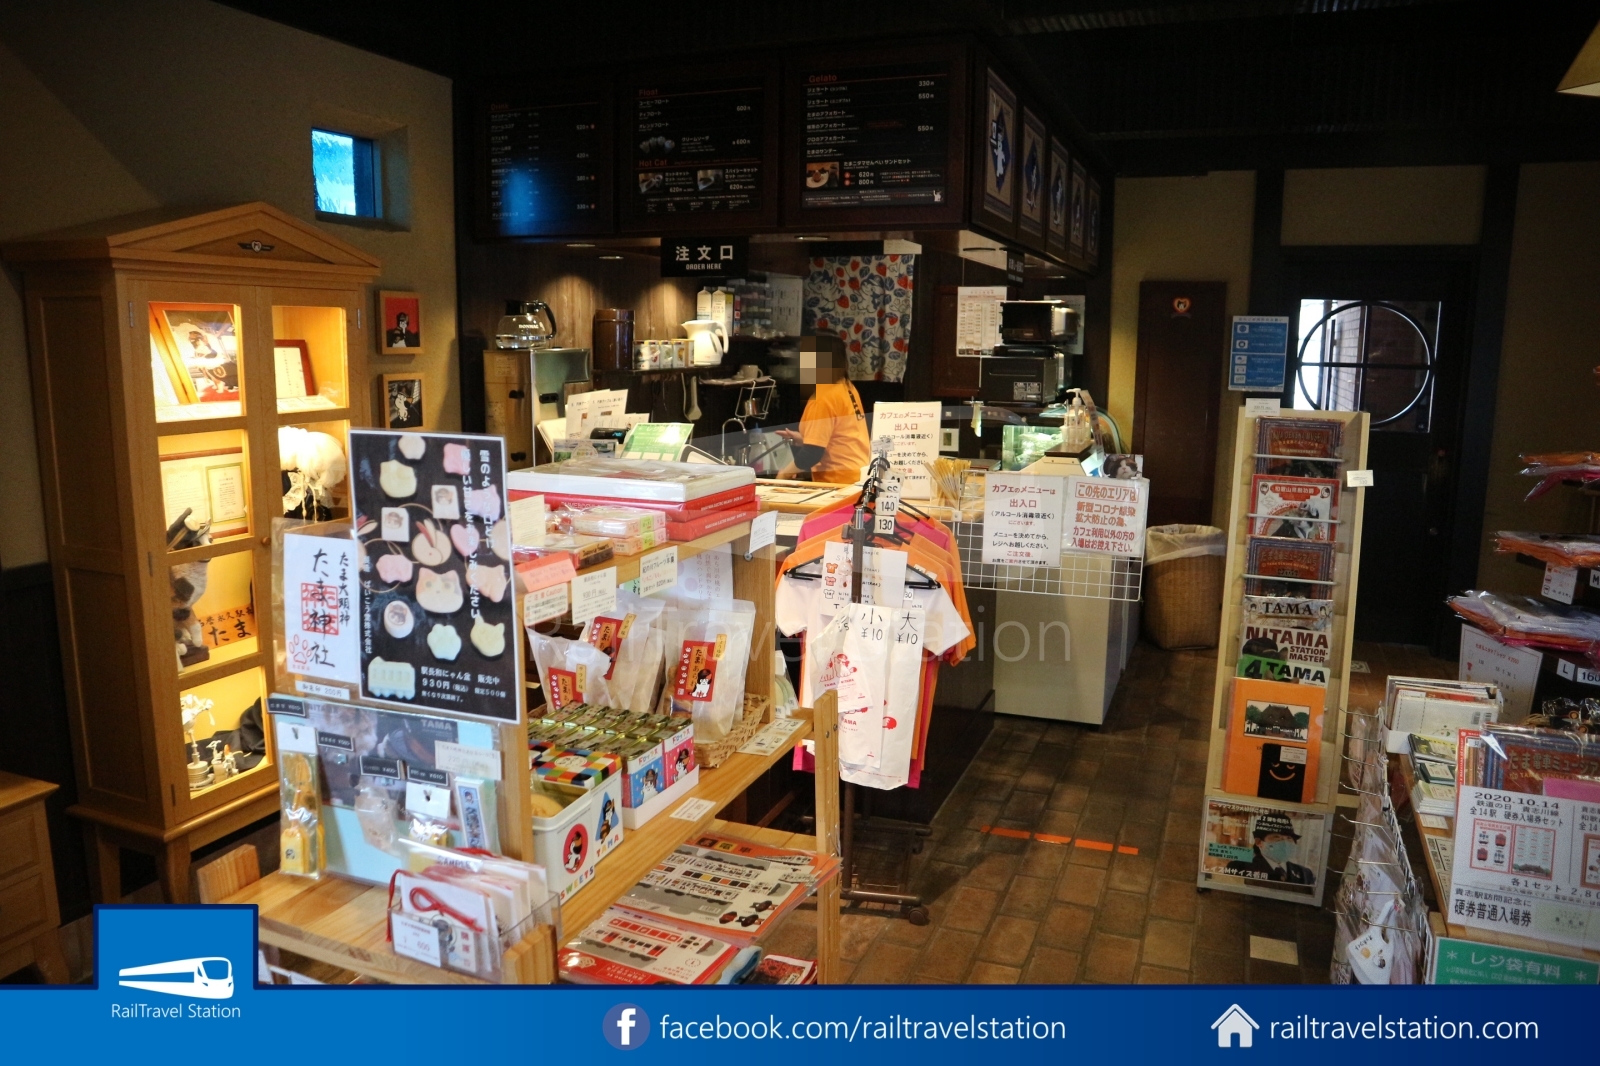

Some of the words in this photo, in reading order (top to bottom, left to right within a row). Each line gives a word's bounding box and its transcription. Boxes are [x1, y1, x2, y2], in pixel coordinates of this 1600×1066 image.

[809, 74, 837, 83] Gelato
[639, 88, 658, 96] Float
[639, 160, 653, 168] Hot
[675, 244, 734, 261] 注文口
[706, 262, 722, 270] HERE
[880, 412, 934, 420] カフェのメニューは
[894, 423, 918, 431] 出入口
[992, 484, 1056, 495] カフェのメニューは
[1078, 484, 1136, 502] この先のエリアは
[881, 500, 895, 512] 140
[1010, 499, 1037, 508] 出入口
[1076, 501, 1136, 516] 新型コロナ感染
[878, 519, 892, 530] 130
[1075, 512, 1128, 528] 拡大防止の為、
[994, 532, 1050, 540] メニューを決めてから、
[1072, 526, 1134, 541] カフェ利用以外の方の
[992, 540, 1050, 550] レジへお越しください。
[1070, 538, 1133, 553] 入場はお控え下さい。
[1592, 574, 1600, 586] M
[1262, 602, 1314, 616] TAMA
[862, 608, 883, 624] 小
[900, 612, 918, 632] 大
[208, 618, 252, 646] たま
[861, 627, 883, 641] ¥10
[896, 632, 918, 645] ¥10
[1246, 626, 1328, 649] NITAMA
[1289, 652, 1326, 664] MASTER
[1562, 664, 1568, 674] L
[478, 674, 500, 686] 販売中
[1582, 672, 1600, 682] 160
[324, 687, 342, 698] 200円
[420, 719, 452, 731] TAMA
[1474, 792, 1560, 810] 2020.10.14
[1476, 800, 1512, 811] 鉄道の日
[1522, 806, 1559, 817] 貴志川線
[1470, 806, 1497, 818] 全14駅
[1504, 810, 1564, 828] 硬券入場券セット
[1581, 814, 1600, 823] 和歌
[596, 834, 619, 858] TAMA
[560, 866, 594, 900] SWEETS
[1511, 878, 1562, 892] 各1セット
[1455, 888, 1532, 908] 貴志駅訪問記念に
[1454, 898, 1532, 927] 硬券普通入場券
[1470, 952, 1561, 980] レジ袋有料
